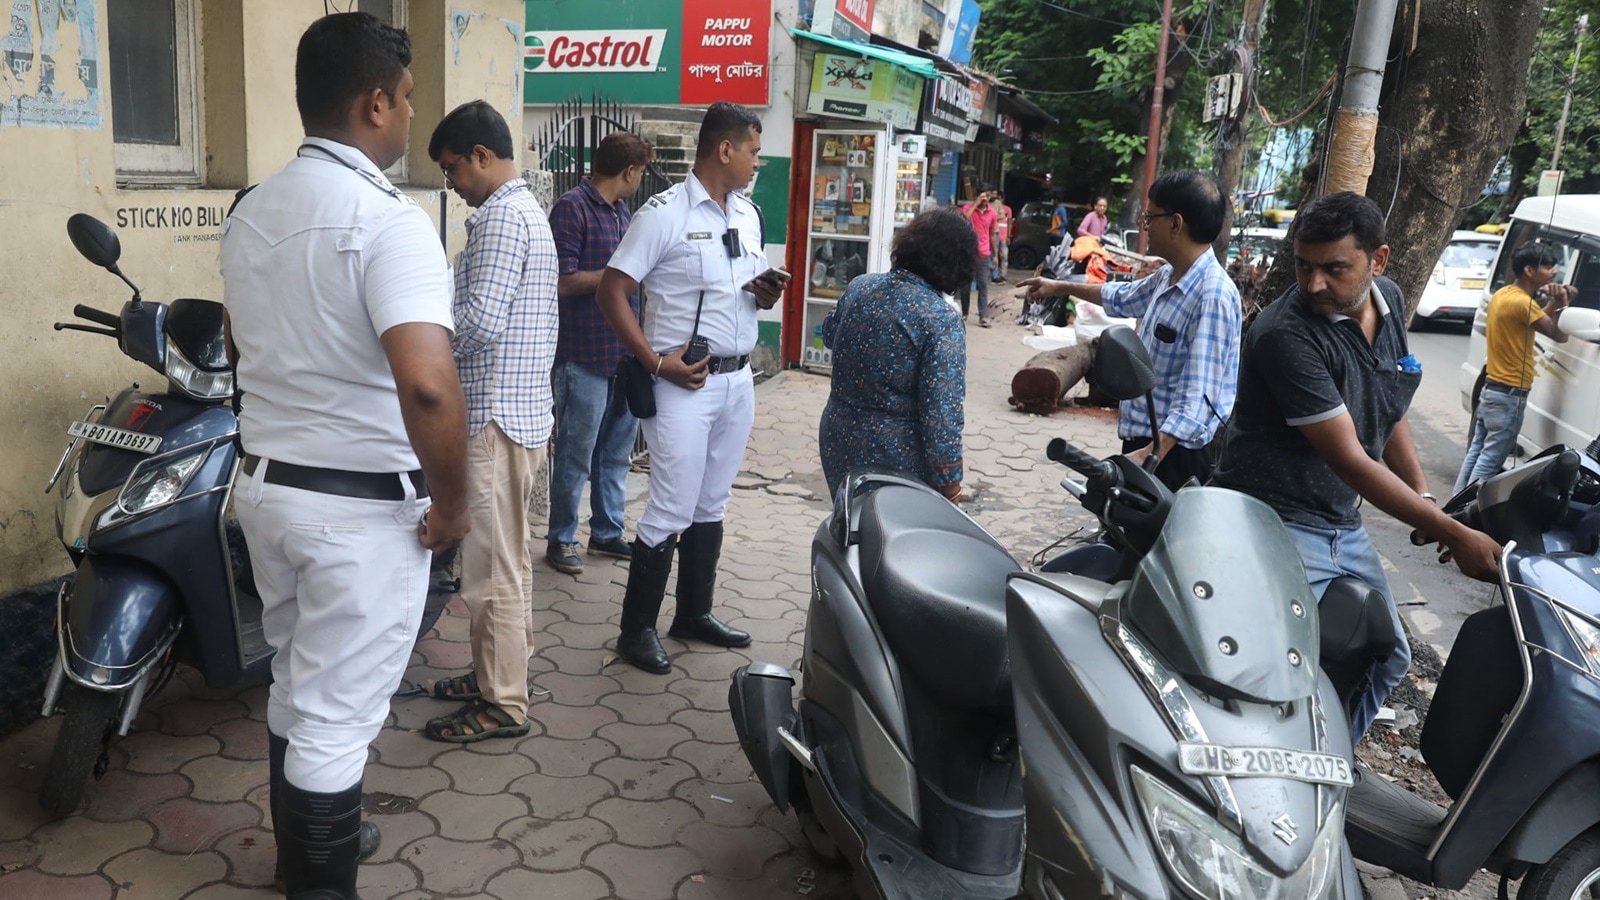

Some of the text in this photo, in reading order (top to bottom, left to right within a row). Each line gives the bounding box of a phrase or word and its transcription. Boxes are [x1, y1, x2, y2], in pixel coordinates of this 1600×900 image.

[704, 18, 751, 30] PAPPU
[701, 34, 753, 47] MOTOR
[548, 35, 653, 69] Castrol
[726, 60, 764, 78] মোটর
[116, 206, 168, 229] STICK
[171, 206, 193, 228] NO
[1243, 750, 1297, 774] 20BE
[1303, 755, 1348, 780] 2075
